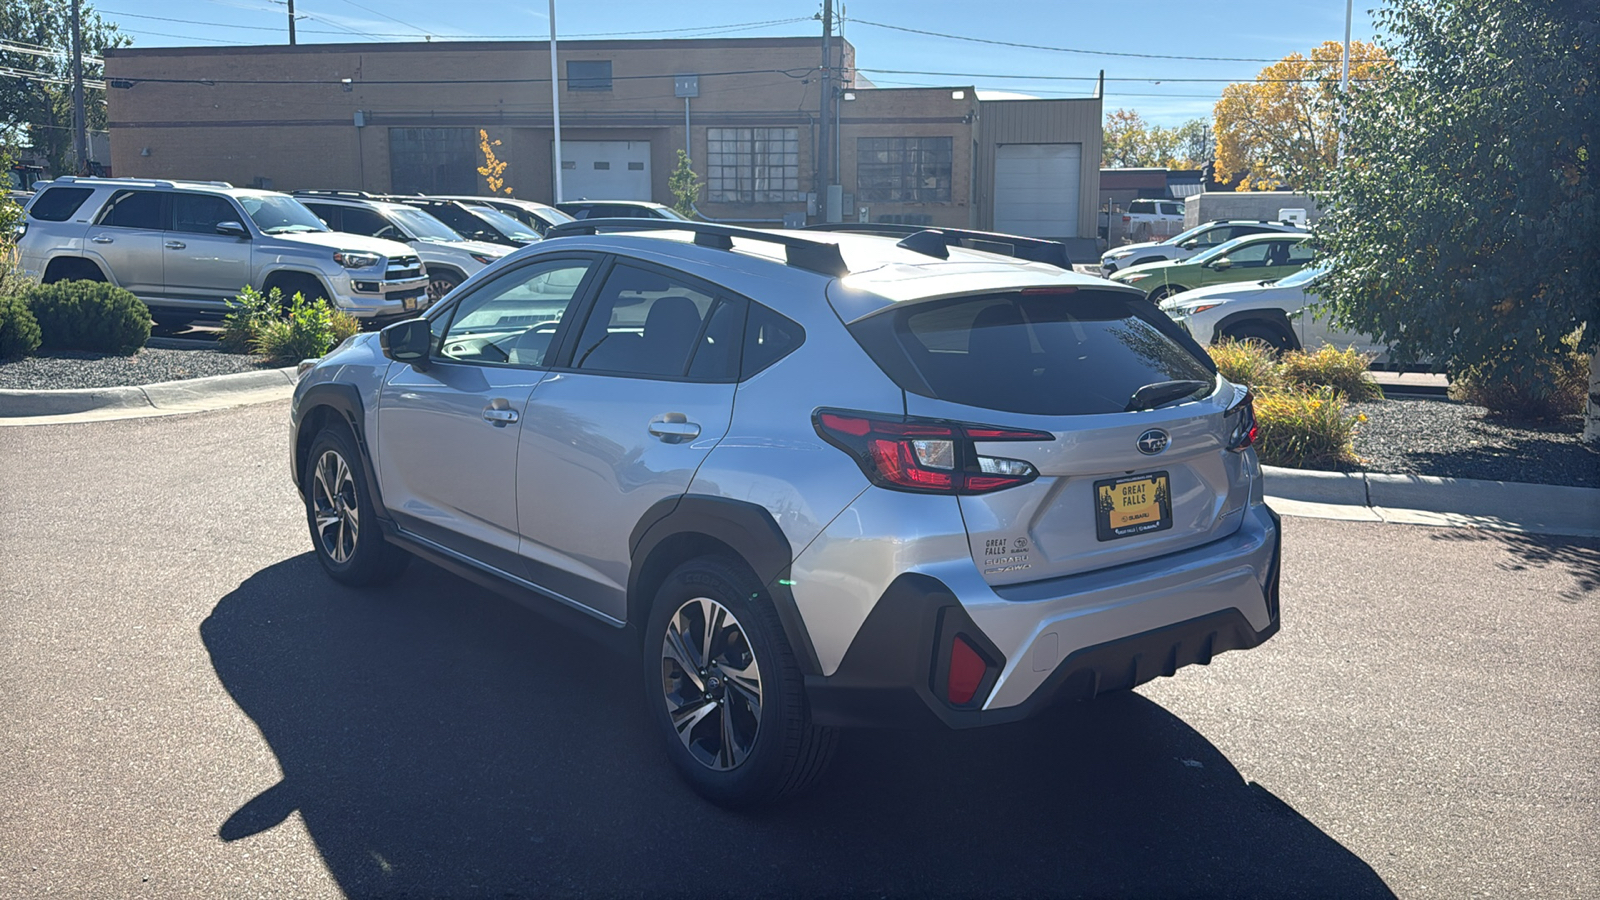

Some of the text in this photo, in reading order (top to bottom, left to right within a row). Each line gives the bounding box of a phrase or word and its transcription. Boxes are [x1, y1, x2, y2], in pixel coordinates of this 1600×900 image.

[1122, 484, 1146, 496] GREAT
[1122, 494, 1146, 506] FALLS
[986, 538, 1006, 547] GREAT
[985, 547, 1006, 555] FALLS
[985, 555, 1029, 566] SUBARU
